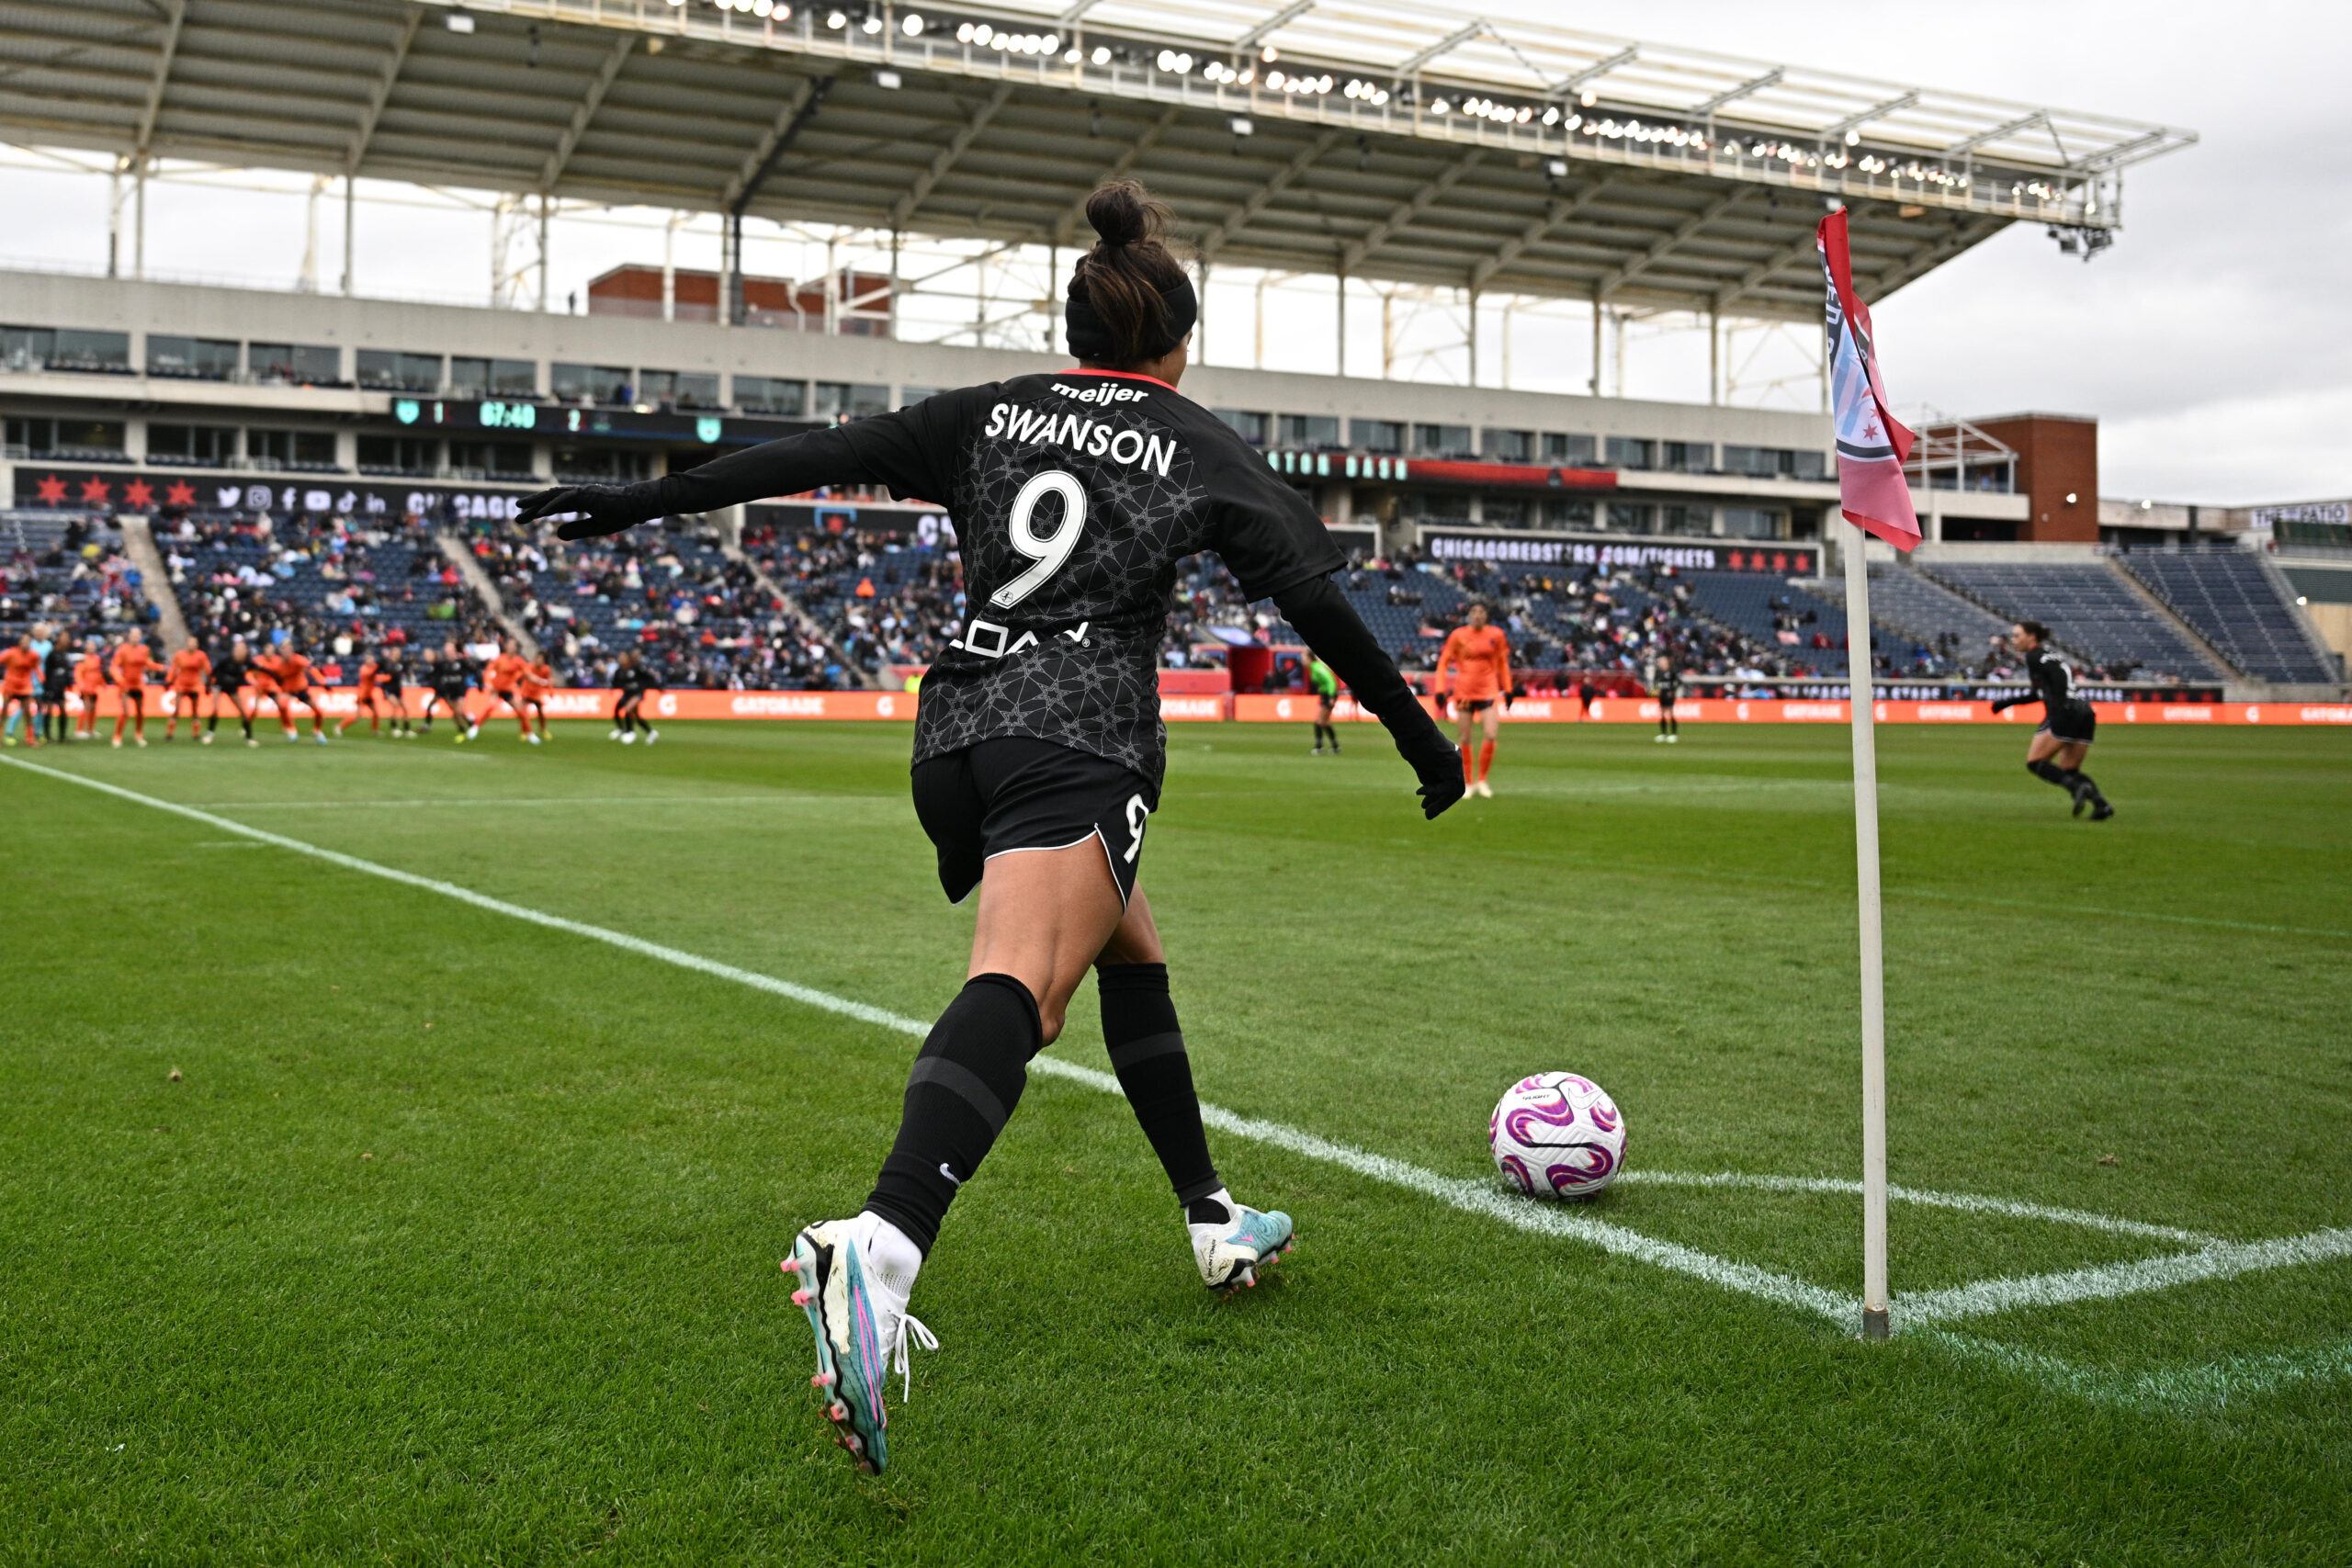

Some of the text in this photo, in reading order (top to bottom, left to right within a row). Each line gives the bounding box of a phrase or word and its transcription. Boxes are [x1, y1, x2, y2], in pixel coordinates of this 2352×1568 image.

[1051, 383, 1148, 406] meijer
[985, 403, 1177, 477] SWANSON
[989, 469, 1087, 610] 9
[731, 696, 825, 715] GATORADE
[1123, 793, 1149, 864] 9
